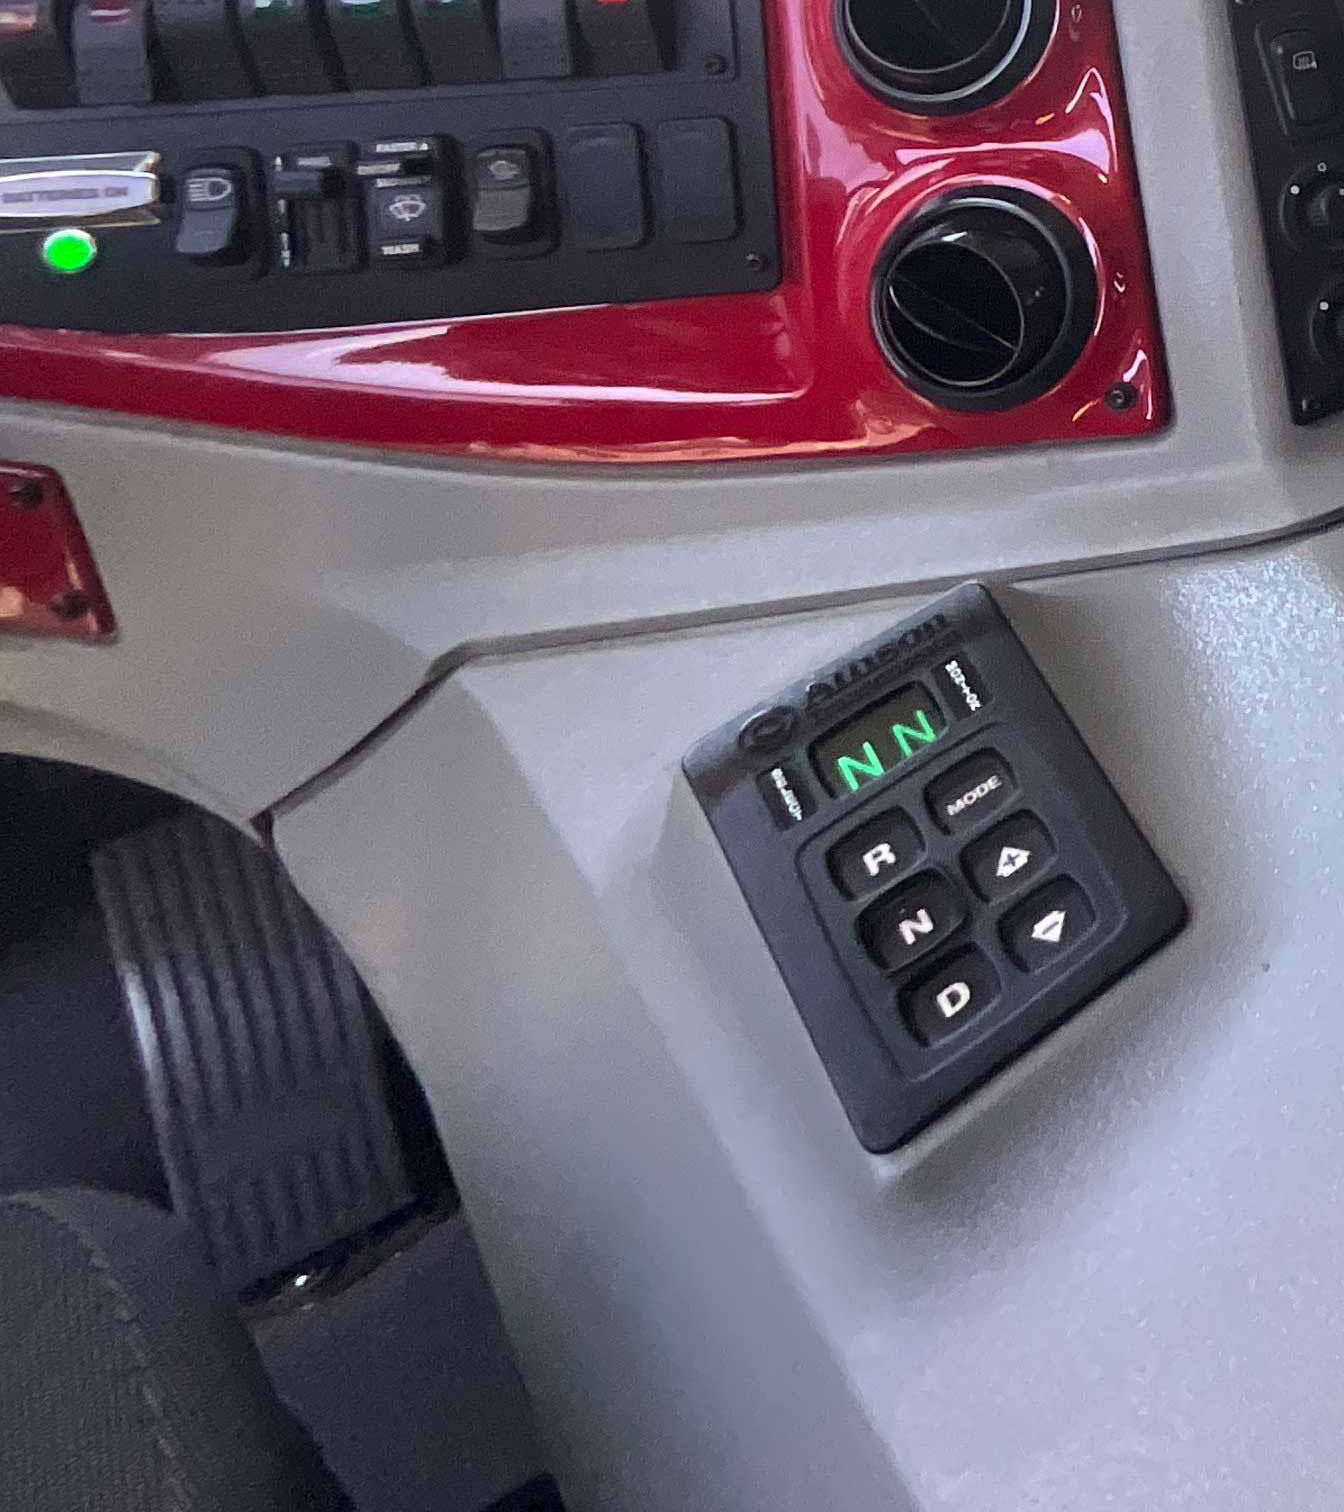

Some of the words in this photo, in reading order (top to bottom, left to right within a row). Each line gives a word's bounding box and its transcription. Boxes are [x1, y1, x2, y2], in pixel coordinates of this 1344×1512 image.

[803, 611, 950, 711] Allison
[837, 741, 885, 792] N
[892, 709, 937, 757] N
[947, 774, 1002, 816] MODE
[862, 842, 897, 876] R
[899, 907, 934, 945] N
[936, 981, 971, 1018] D
